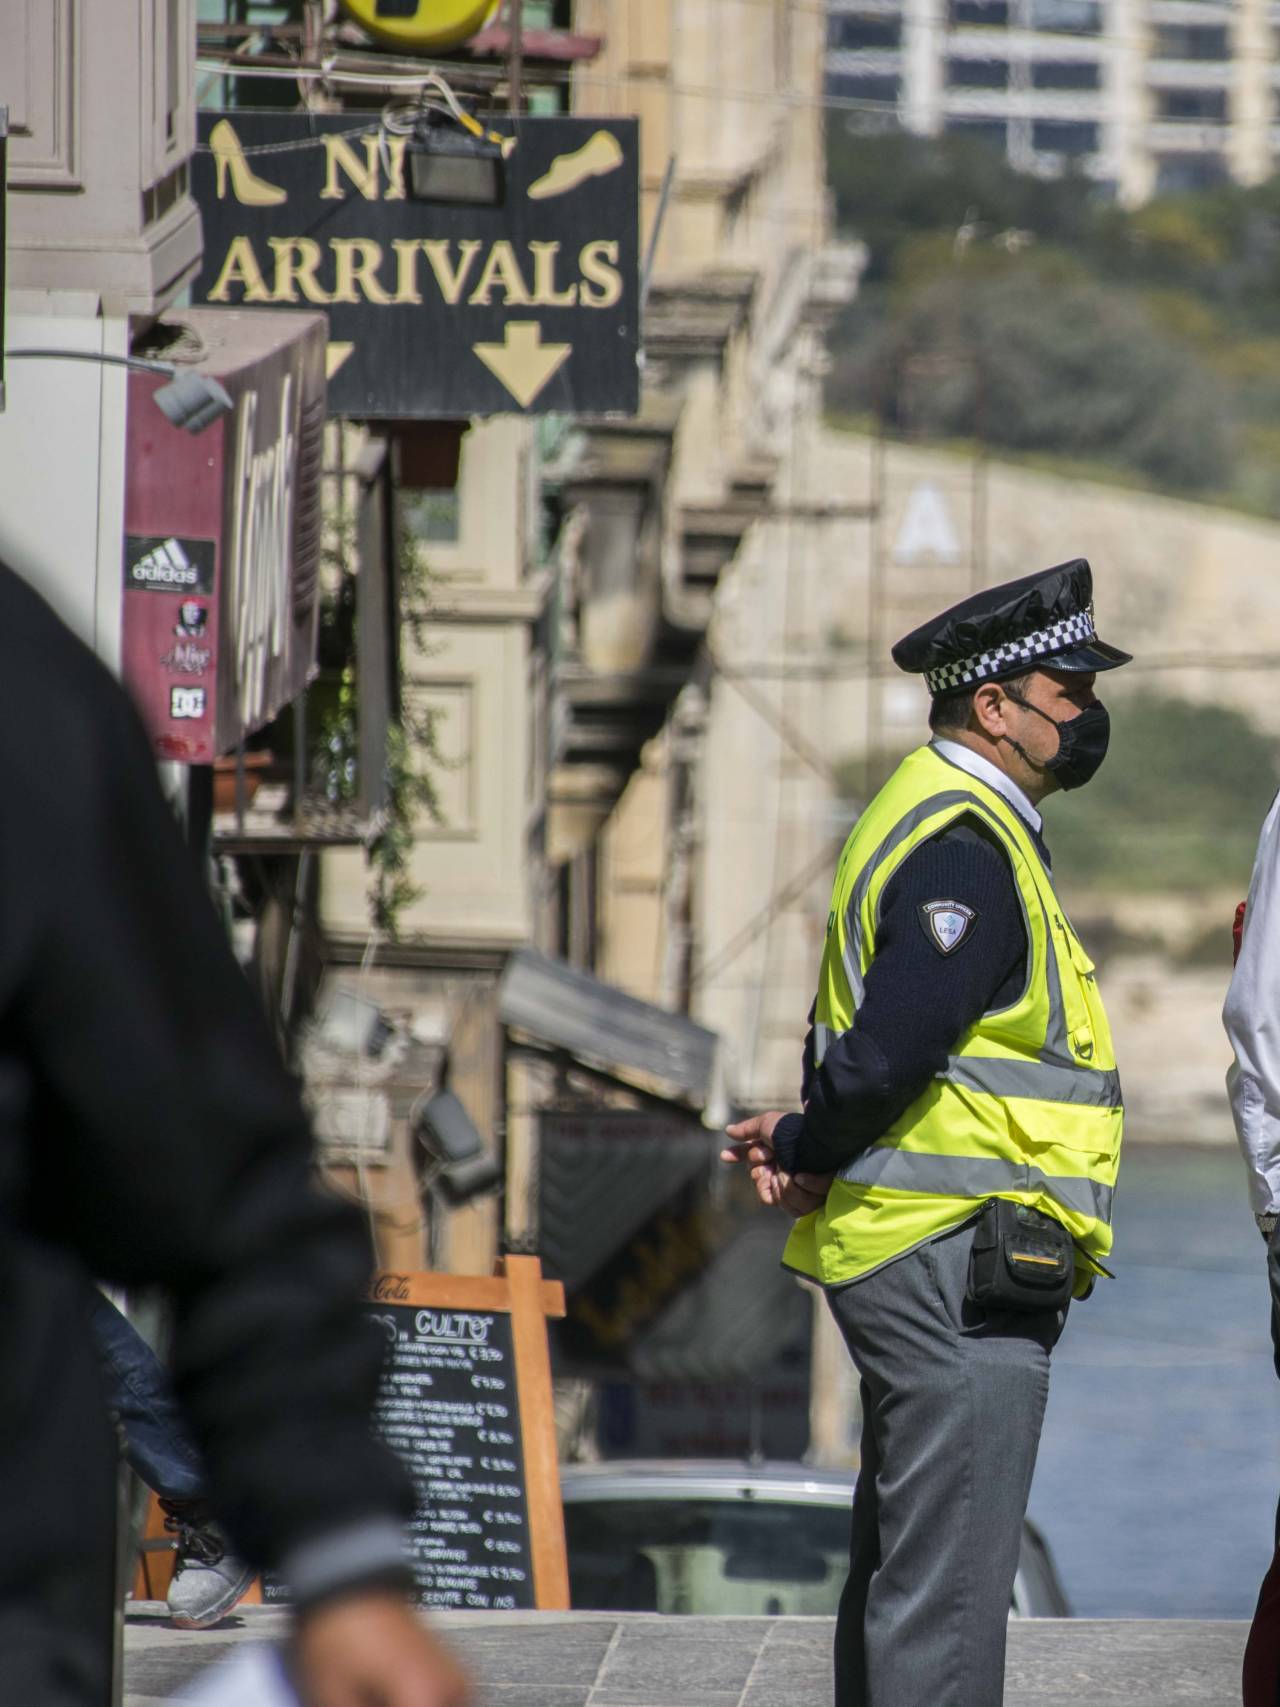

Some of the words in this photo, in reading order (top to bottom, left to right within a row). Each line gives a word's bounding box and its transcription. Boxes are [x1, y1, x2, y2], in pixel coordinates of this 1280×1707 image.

[207, 235, 624, 309] ARRIVALS
[132, 564, 198, 584] adidas
[373, 1275, 410, 1300] Cola
